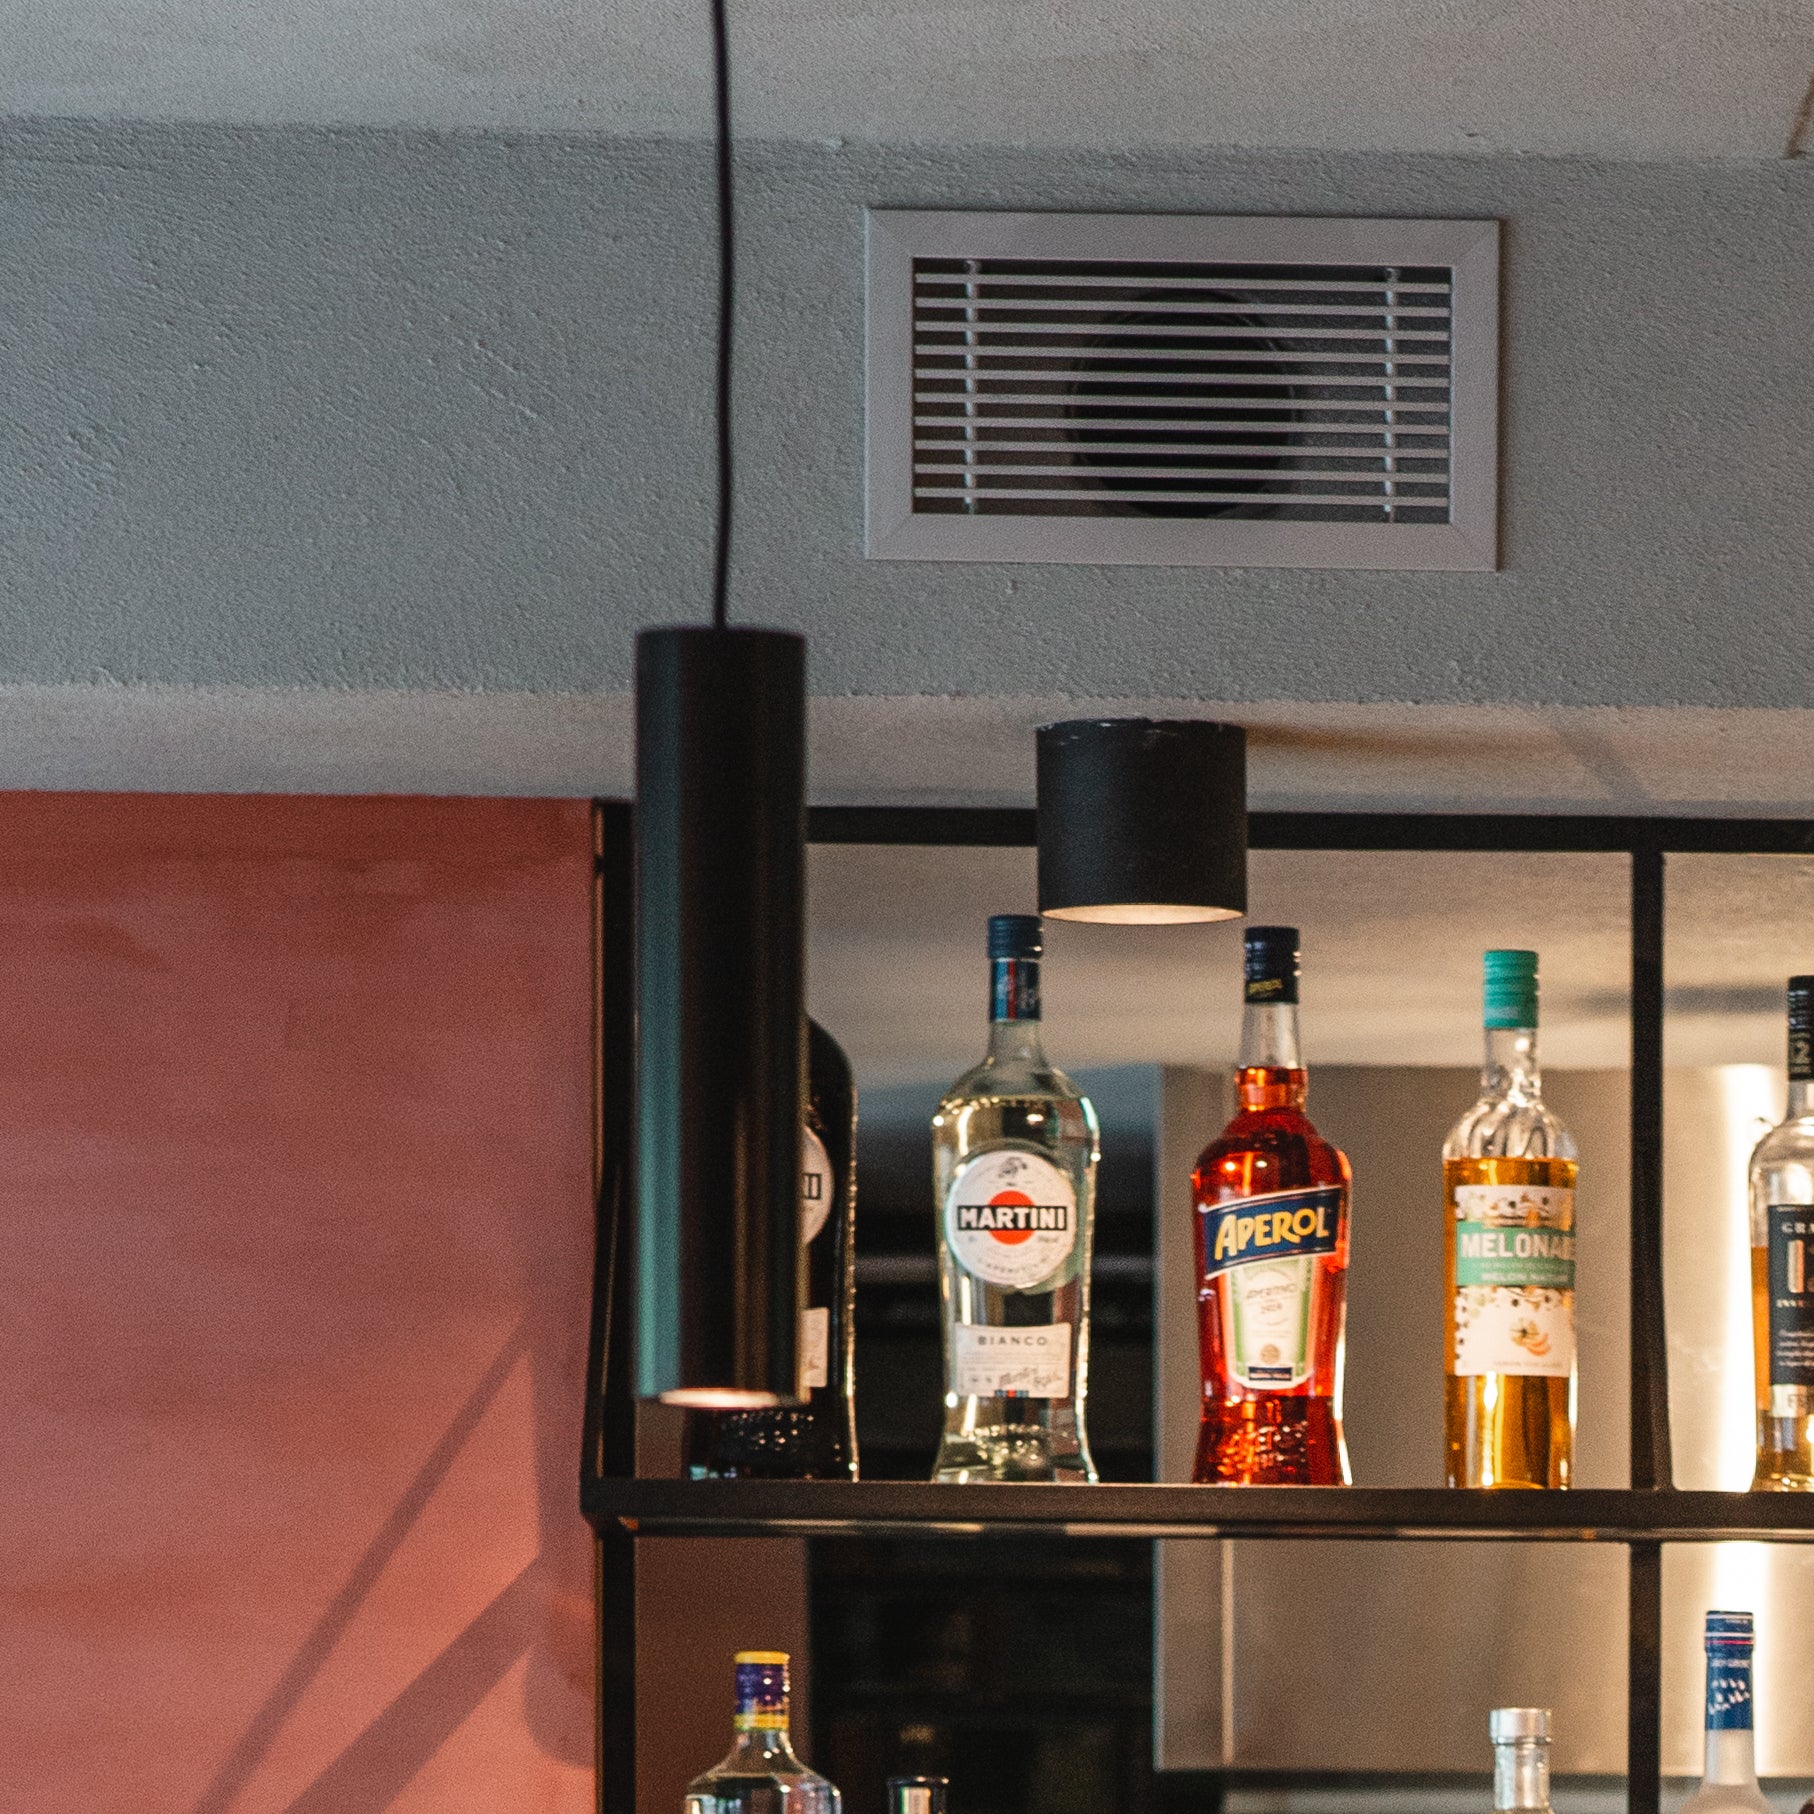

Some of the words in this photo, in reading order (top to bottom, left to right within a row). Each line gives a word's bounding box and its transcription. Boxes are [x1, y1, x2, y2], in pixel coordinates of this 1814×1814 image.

[958, 1207, 1065, 1229] MARTINI
[1214, 1206, 1329, 1260] APEROL
[977, 1335, 1048, 1346] BIANCO
